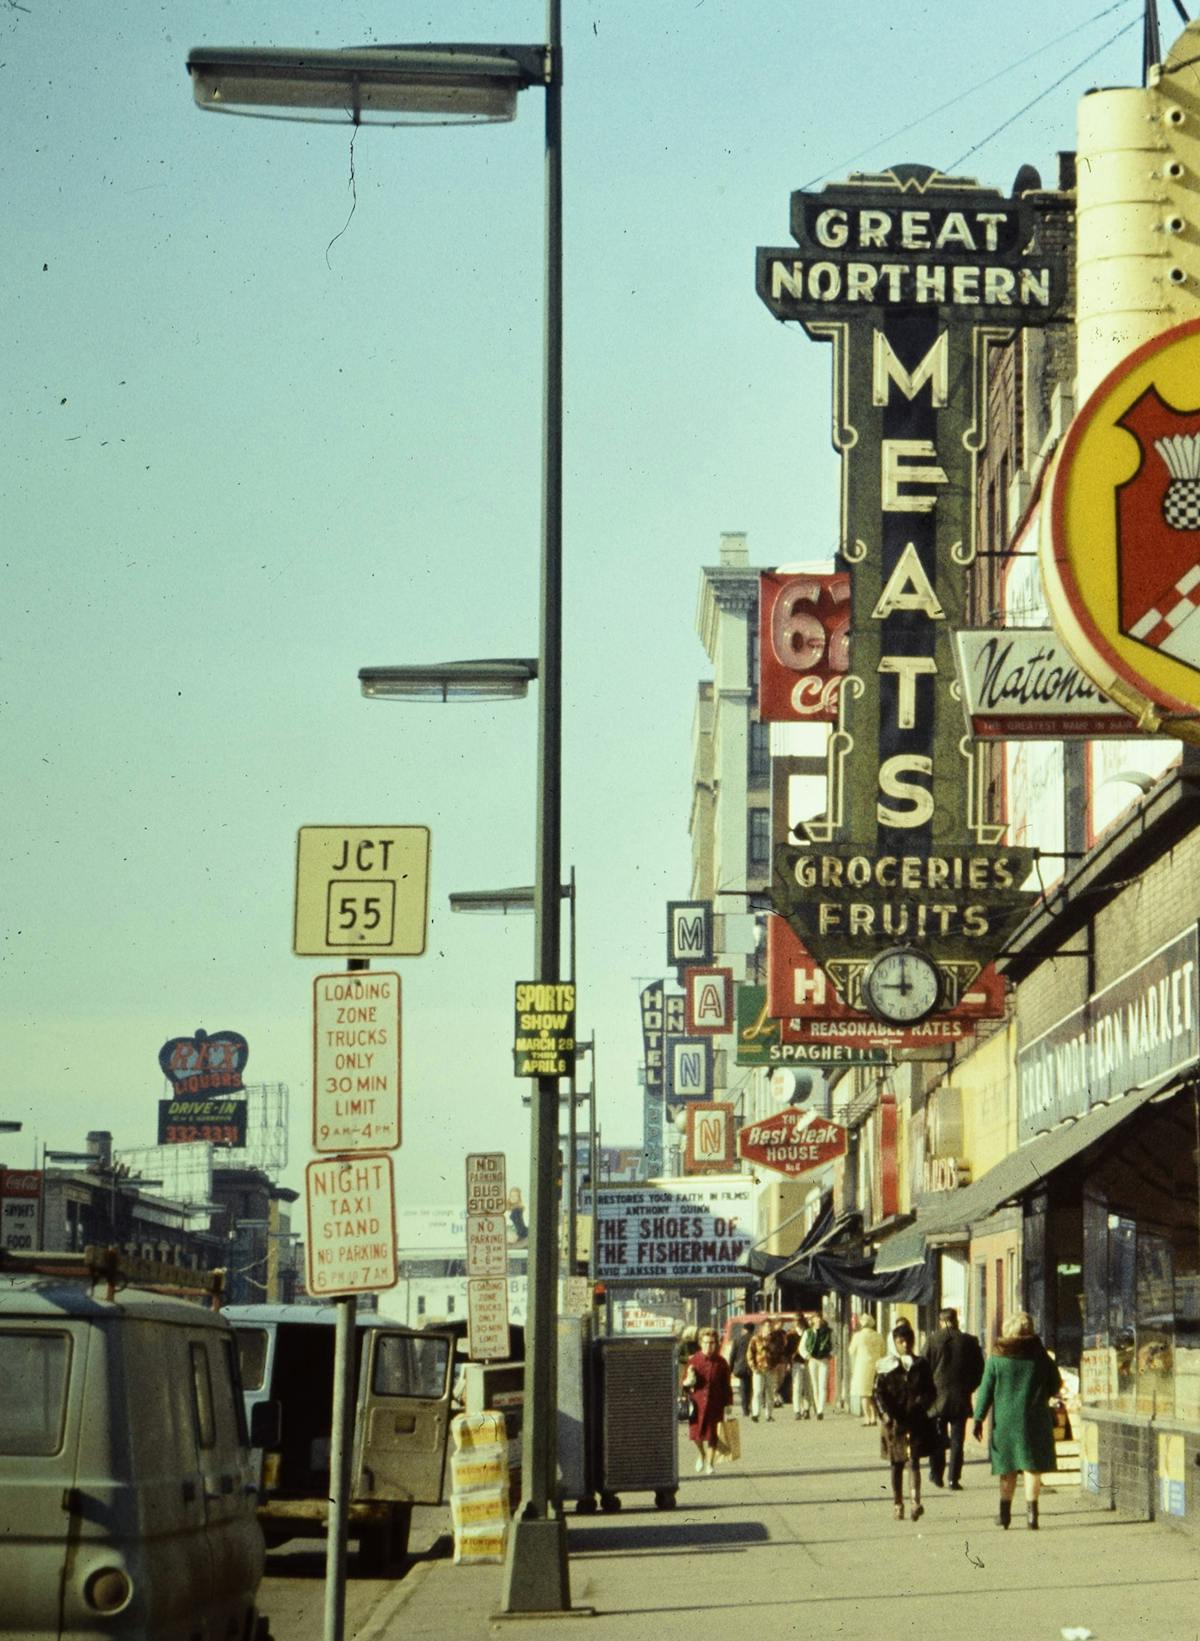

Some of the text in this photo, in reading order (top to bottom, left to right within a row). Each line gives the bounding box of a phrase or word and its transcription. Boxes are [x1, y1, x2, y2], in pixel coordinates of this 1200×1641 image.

[815, 209, 1007, 251] GREAT
[771, 261, 1049, 305] NORTHERN
[871, 327, 949, 828] MEATS
[975, 637, 1110, 708] Nationa
[1008, 721, 1056, 731] GREATEST
[332, 840, 394, 871] JCT
[794, 855, 1014, 889] GROCERIES
[340, 898, 380, 929] 55
[819, 903, 990, 937] FRUITS
[325, 983, 390, 1000] LOADING
[517, 984, 574, 1011] SPORTS
[337, 1007, 377, 1023] ZONE
[1129, 961, 1193, 1060] MARKET
[521, 1014, 568, 1030] SHOW
[912, 1021, 962, 1036] RATES
[327, 1029, 387, 1047] TRUCKS
[516, 1038, 555, 1051] MARCH
[642, 990, 663, 1084] HOTEL
[678, 925, 722, 1153] MANN
[335, 1054, 374, 1070] ONLY
[522, 1059, 557, 1073] APRIL
[326, 1076, 387, 1093] 30 MIN
[168, 1102, 237, 1114] DRIVE-IN
[335, 1099, 375, 1116] LIMIT
[320, 1125, 329, 1140] 9
[748, 1126, 838, 1145] Best Steak
[767, 1145, 818, 1161] HOUSE
[476, 1159, 497, 1171] NO
[314, 1165, 382, 1195] NIGHT
[470, 1172, 502, 1181] PARKING
[473, 1185, 500, 1197] BUS
[598, 1194, 645, 1205] RESTORES
[650, 1192, 673, 1202] YOUR
[676, 1191, 704, 1201] FAITH
[331, 1197, 371, 1216] TAXI
[469, 1199, 504, 1210] STOP
[626, 1204, 710, 1216] ANTHONY QUINN
[324, 1219, 379, 1239] STAND
[478, 1221, 494, 1232] NO
[640, 1217, 703, 1239] SHOES
[714, 1216, 739, 1238] OF
[470, 1235, 503, 1244] PARKING
[318, 1244, 387, 1264] NO PARKING
[318, 1271, 327, 1287] 6
[362, 1267, 370, 1283] 7
[598, 1267, 620, 1276] AVID
[625, 1266, 668, 1276] JANSSEN
[672, 1265, 702, 1275] OSKAR
[472, 1281, 502, 1291] LOADING
